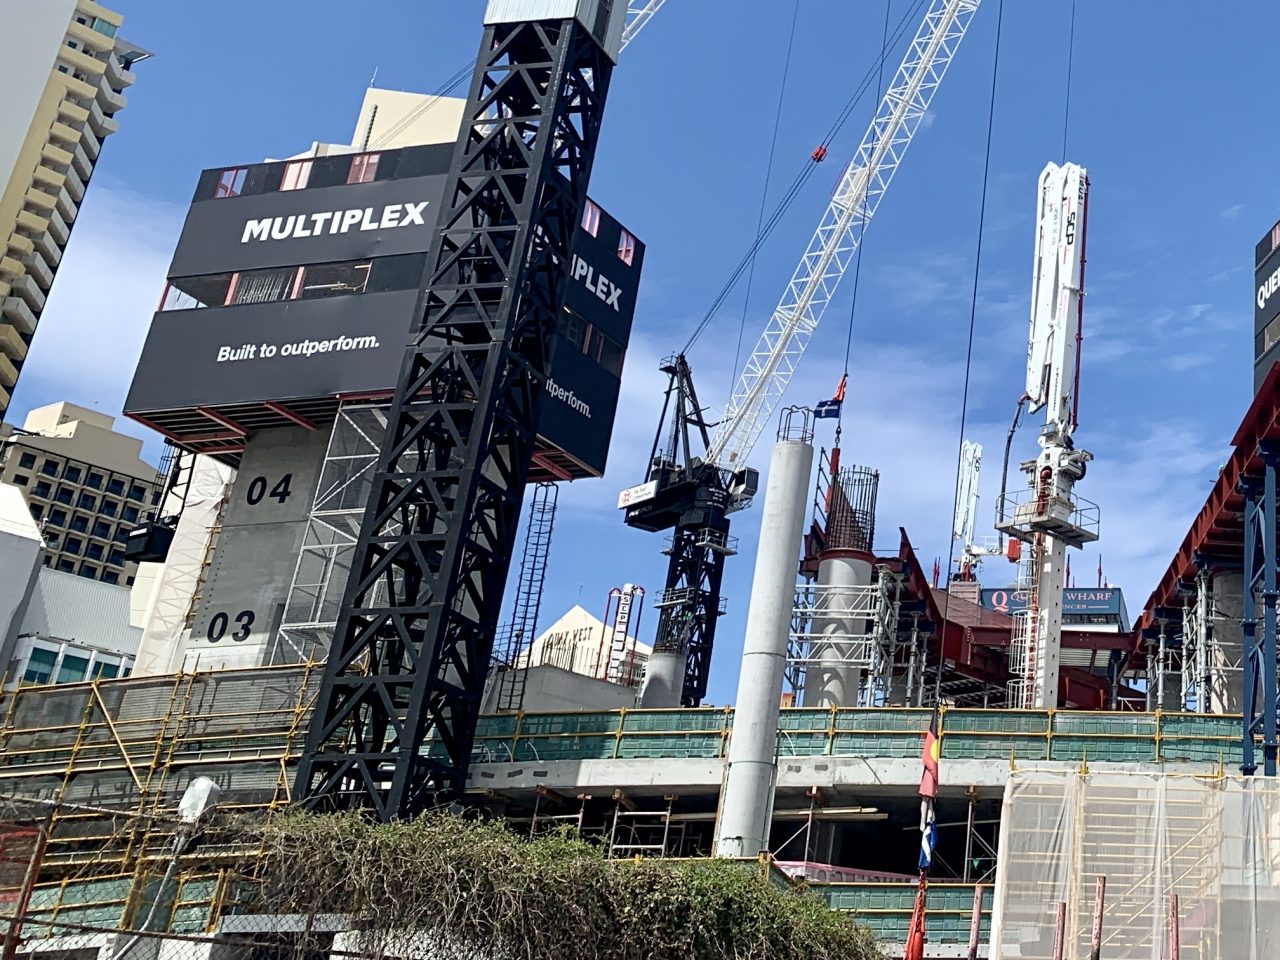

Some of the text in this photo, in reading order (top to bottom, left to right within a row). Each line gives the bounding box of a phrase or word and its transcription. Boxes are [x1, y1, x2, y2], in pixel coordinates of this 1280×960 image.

[241, 201, 429, 243] MULTIPLEX
[1065, 211, 1076, 246] SCP
[217, 332, 380, 363] Built to outperform.
[246, 473, 293, 506] 04
[991, 591, 1009, 612] Q
[1066, 592, 1113, 601] WHARF
[207, 609, 256, 644] 03
